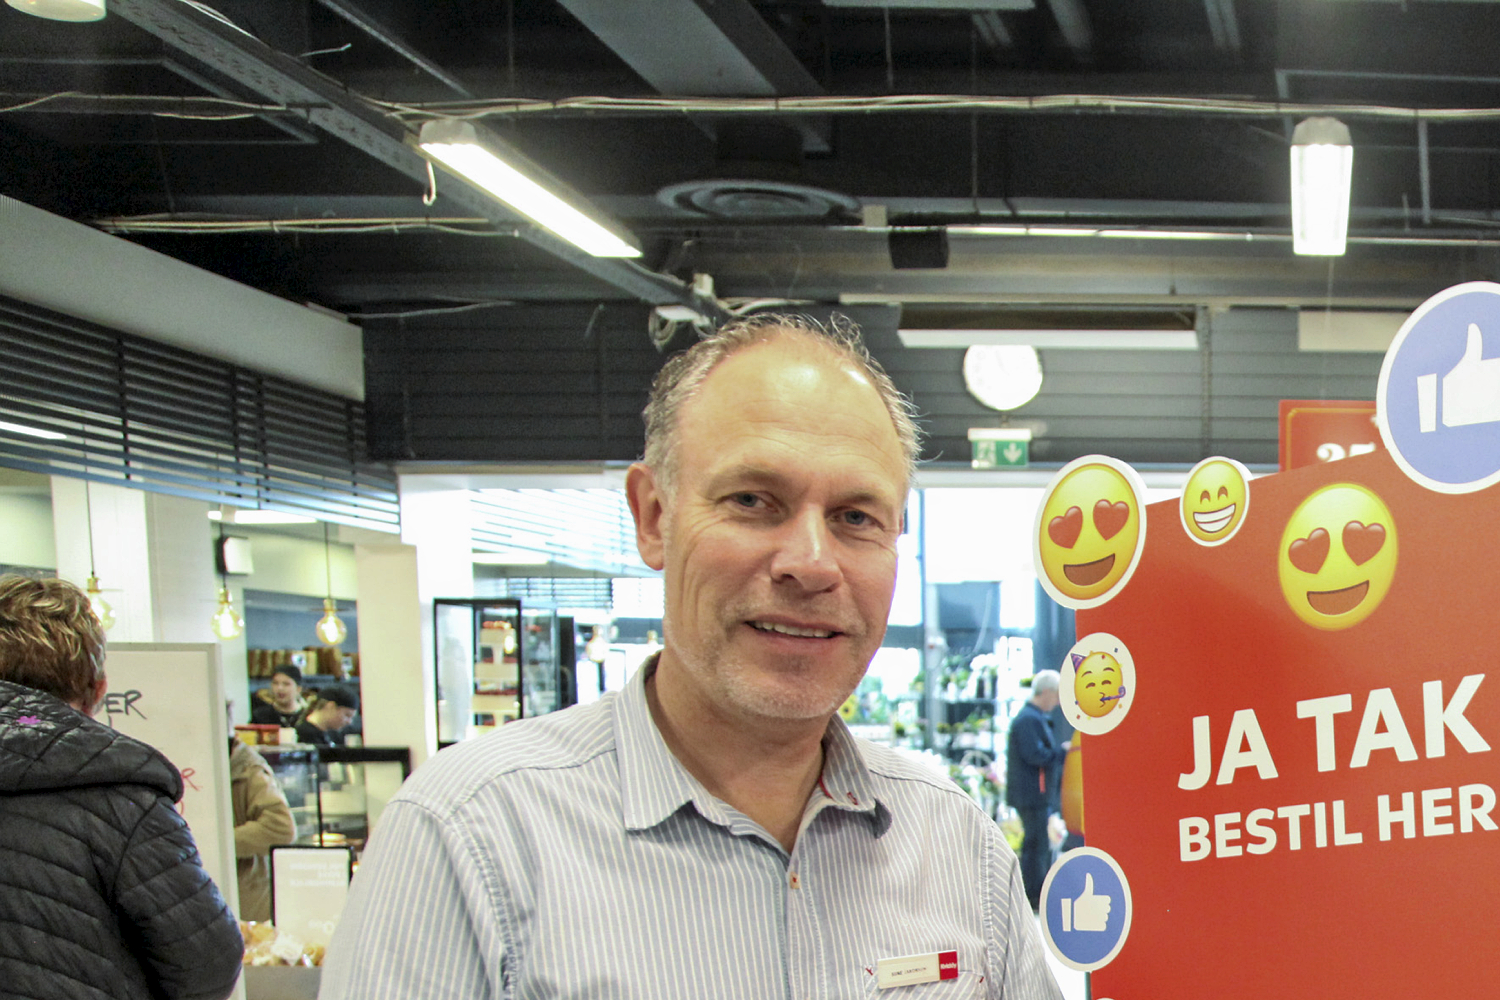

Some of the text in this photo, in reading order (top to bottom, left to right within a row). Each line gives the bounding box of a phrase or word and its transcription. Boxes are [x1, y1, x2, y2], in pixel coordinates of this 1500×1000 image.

[1178, 673, 1492, 790] JA TAK
[1178, 783, 1500, 862] BESTIL HER
